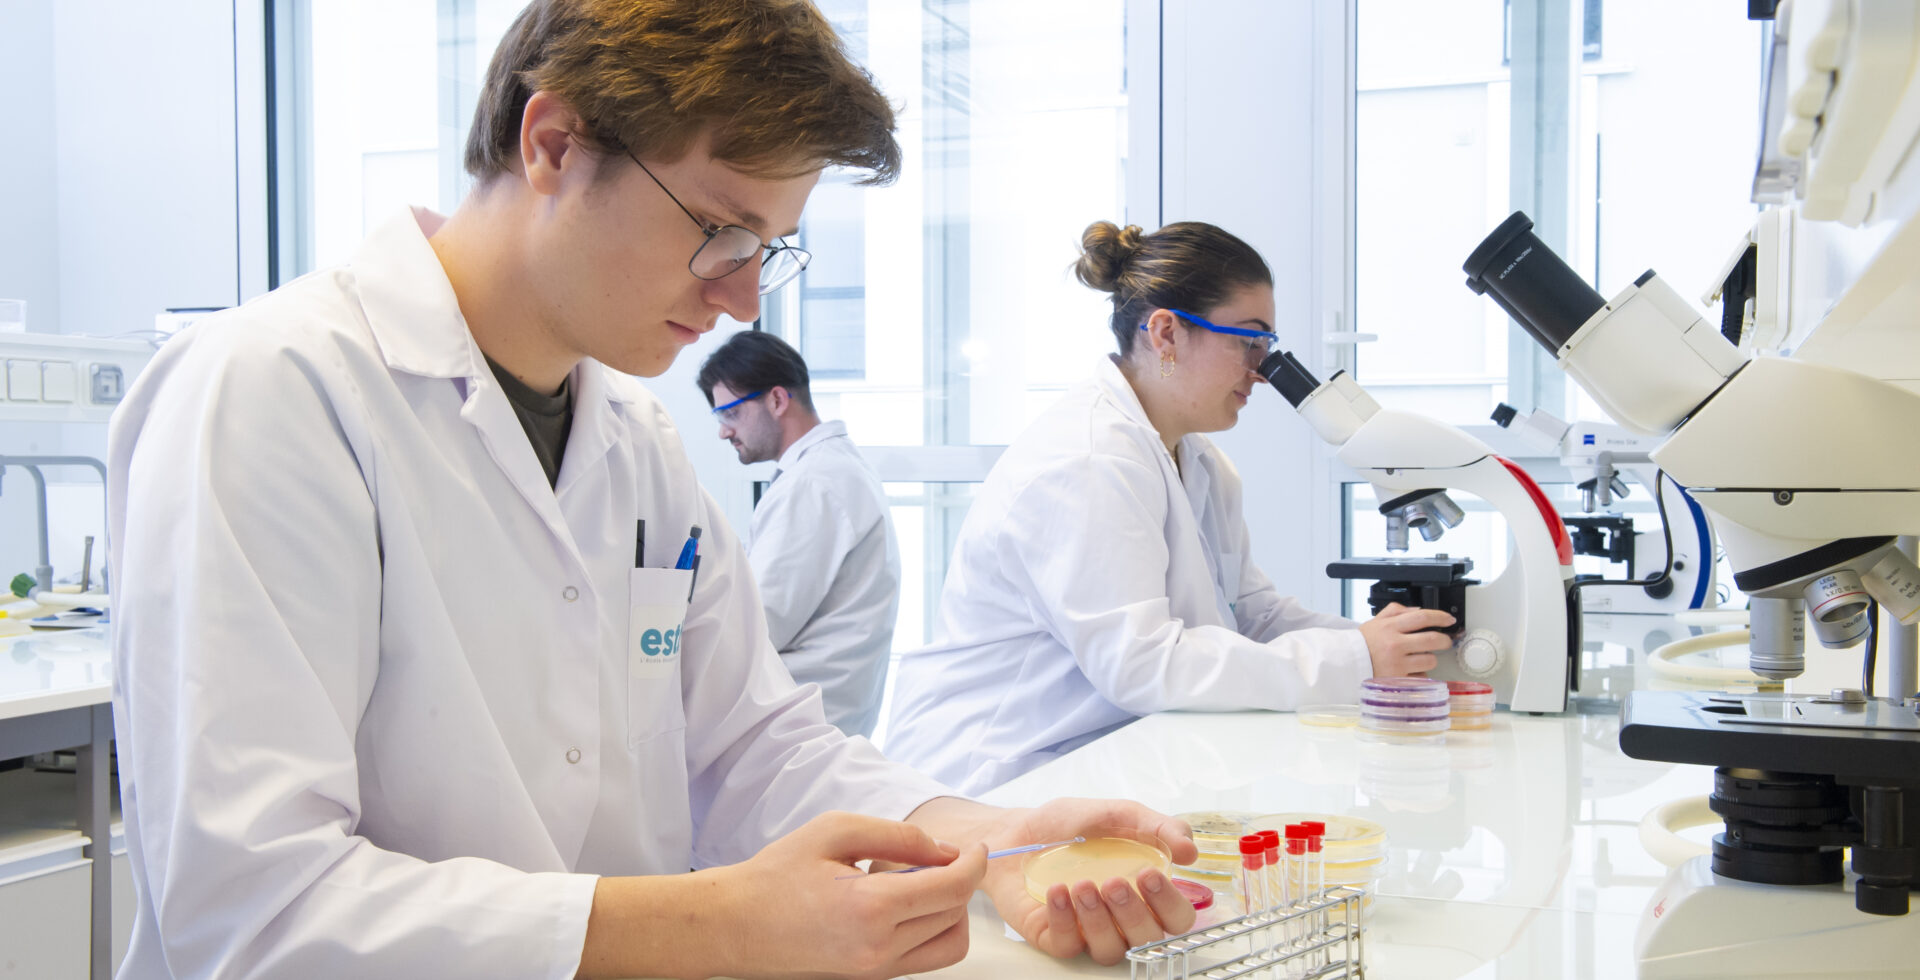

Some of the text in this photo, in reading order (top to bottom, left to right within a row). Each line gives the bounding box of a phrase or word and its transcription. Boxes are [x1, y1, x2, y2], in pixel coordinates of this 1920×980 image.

[1820, 575, 1836, 585] LEICA
[1822, 582, 1838, 590] PLAN
[1899, 582, 1913, 593] PLAN
